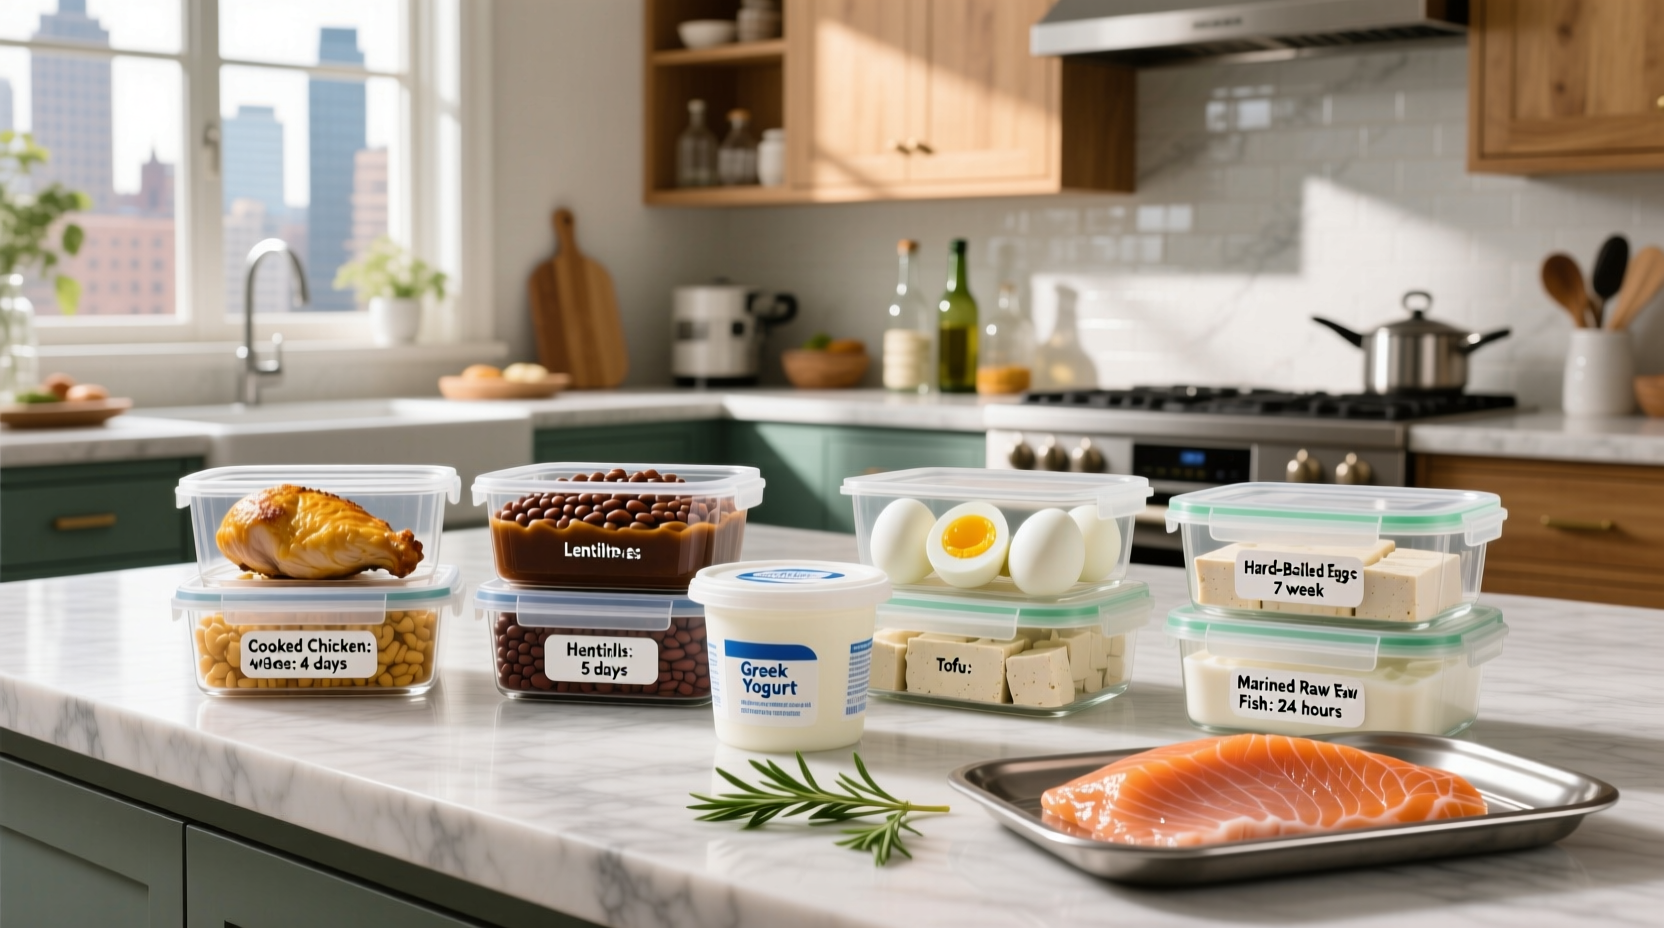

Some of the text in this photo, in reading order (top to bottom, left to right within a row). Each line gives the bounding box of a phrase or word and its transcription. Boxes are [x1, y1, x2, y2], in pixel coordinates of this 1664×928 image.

[1273, 581, 1325, 598] 7 week
[248, 637, 371, 653] Cooked Chicken:
[300, 656, 310, 670] 4
[313, 655, 347, 674] days
[581, 660, 628, 680] 5 days
[740, 661, 789, 678] Greek
[936, 656, 972, 675] Tofu:
[742, 678, 798, 699] Yogurt
[1237, 674, 1295, 693] Marined
[1299, 679, 1330, 697] Raw
[1239, 694, 1342, 719] Fish: 24 hours
